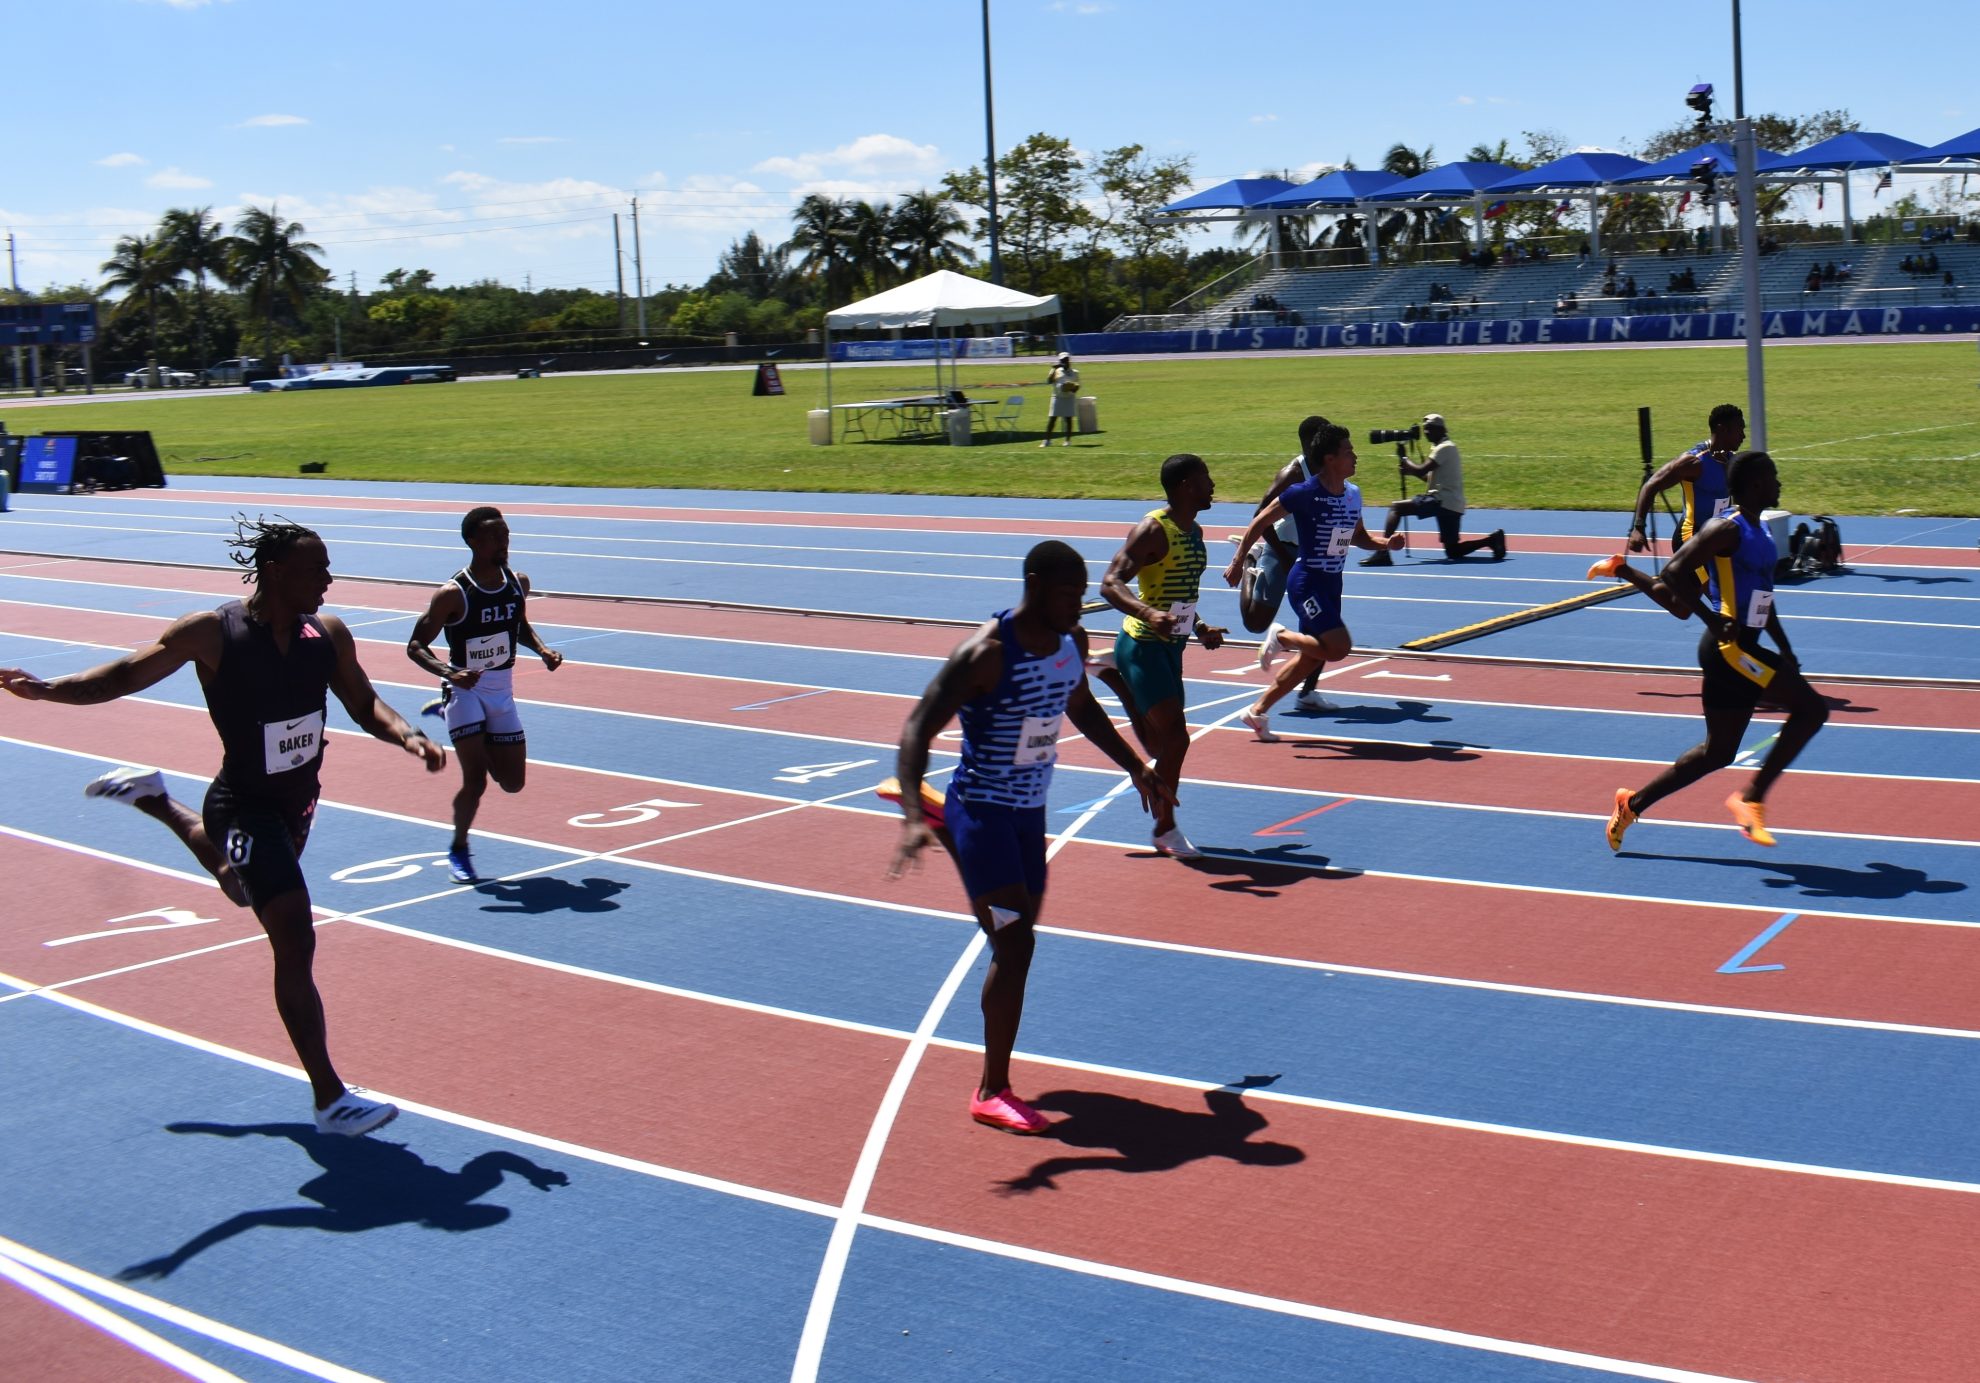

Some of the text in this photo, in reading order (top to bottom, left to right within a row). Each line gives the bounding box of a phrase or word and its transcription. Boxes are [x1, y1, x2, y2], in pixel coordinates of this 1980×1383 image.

[1191, 328, 1264, 351] IT'S
[1294, 322, 1415, 348] RIGHT
[1447, 319, 1552, 344] HERE
[1588, 315, 1632, 341] IN
[481, 603, 516, 623] GLF
[1306, 600, 1318, 617] 3
[470, 646, 508, 660] WELLS JR.
[279, 733, 313, 754] BAKER
[772, 759, 879, 784] 4
[567, 799, 704, 828] 5
[230, 832, 250, 864] 8
[43, 906, 220, 948] 7
